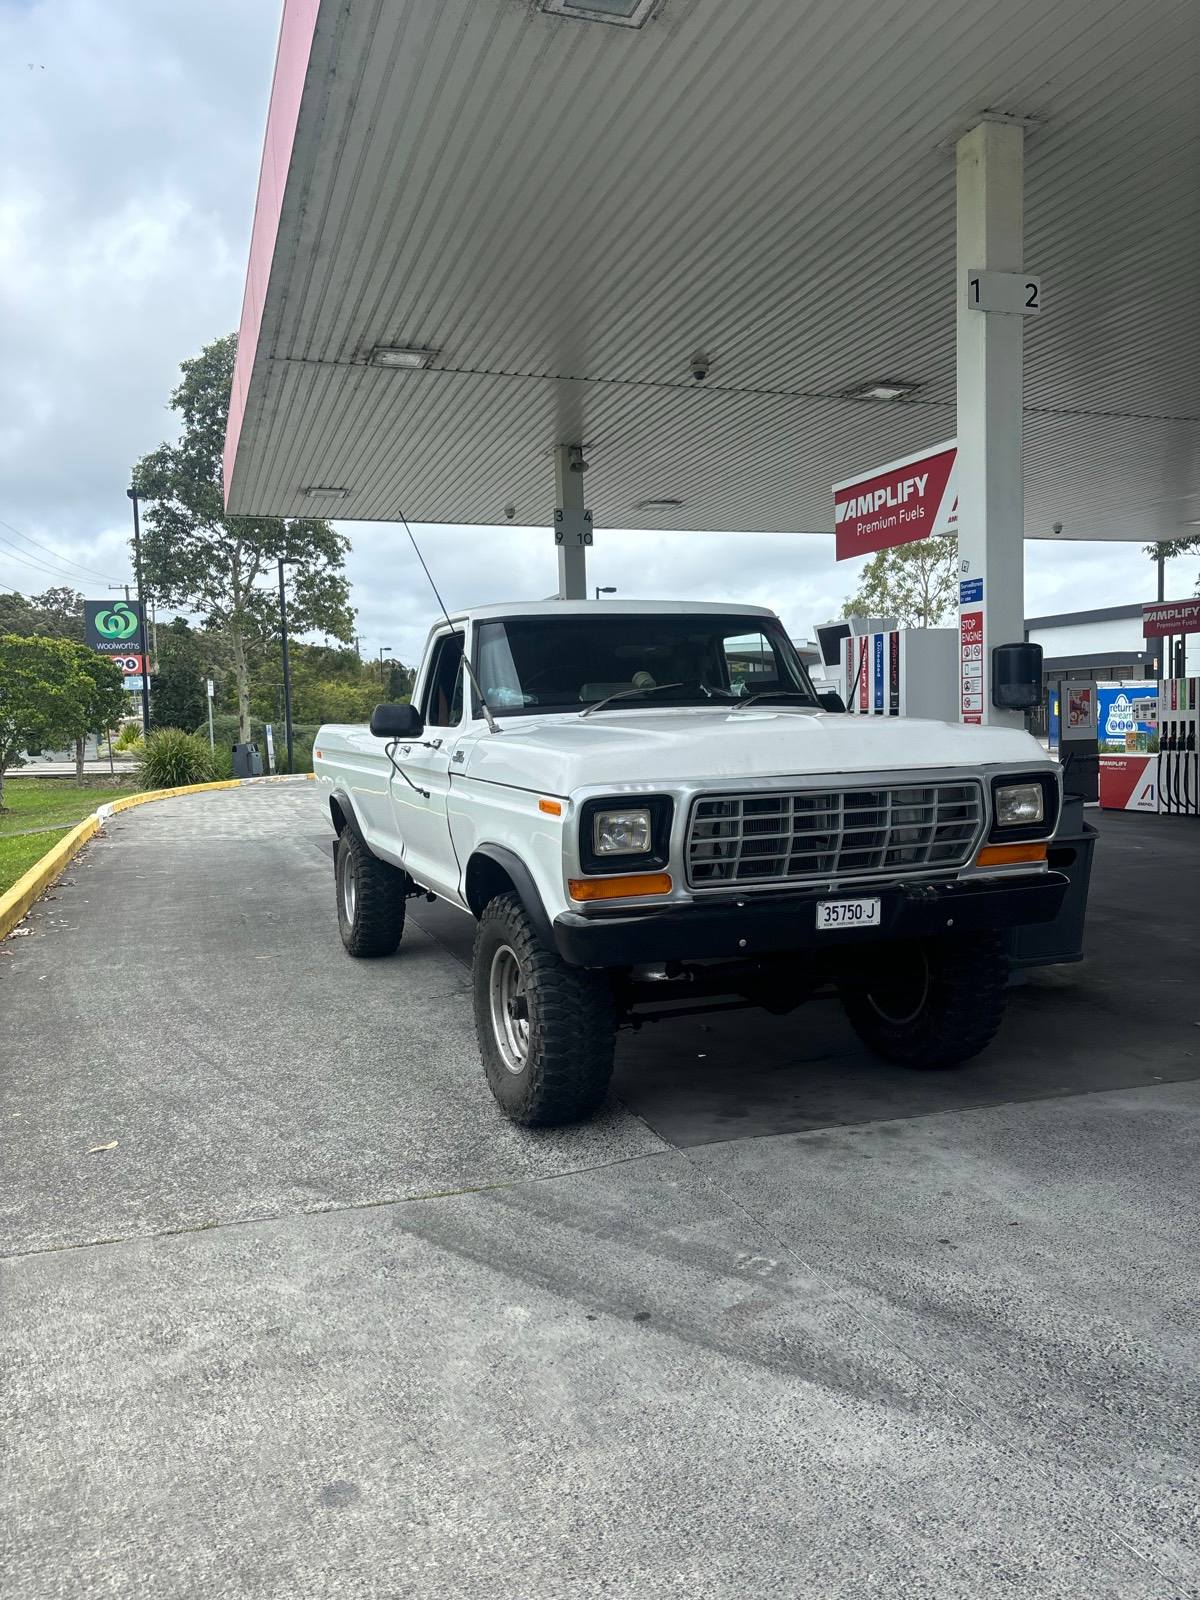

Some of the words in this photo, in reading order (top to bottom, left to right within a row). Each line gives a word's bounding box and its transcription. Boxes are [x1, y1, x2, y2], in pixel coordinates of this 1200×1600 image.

[970, 278, 980, 303] 1
[1025, 283, 1039, 308] 2
[844, 473, 928, 522] AMPLIFY
[555, 510, 564, 522] 3
[583, 511, 593, 523] 4
[857, 515, 897, 536] Premium
[899, 504, 925, 523] Fuels
[555, 531, 564, 544] 9
[576, 532, 593, 545] 10
[1149, 606, 1200, 622] AMPLIFY
[961, 619, 976, 631] STOP
[961, 630, 983, 643] ENGINE
[96, 641, 140, 650] woolworths
